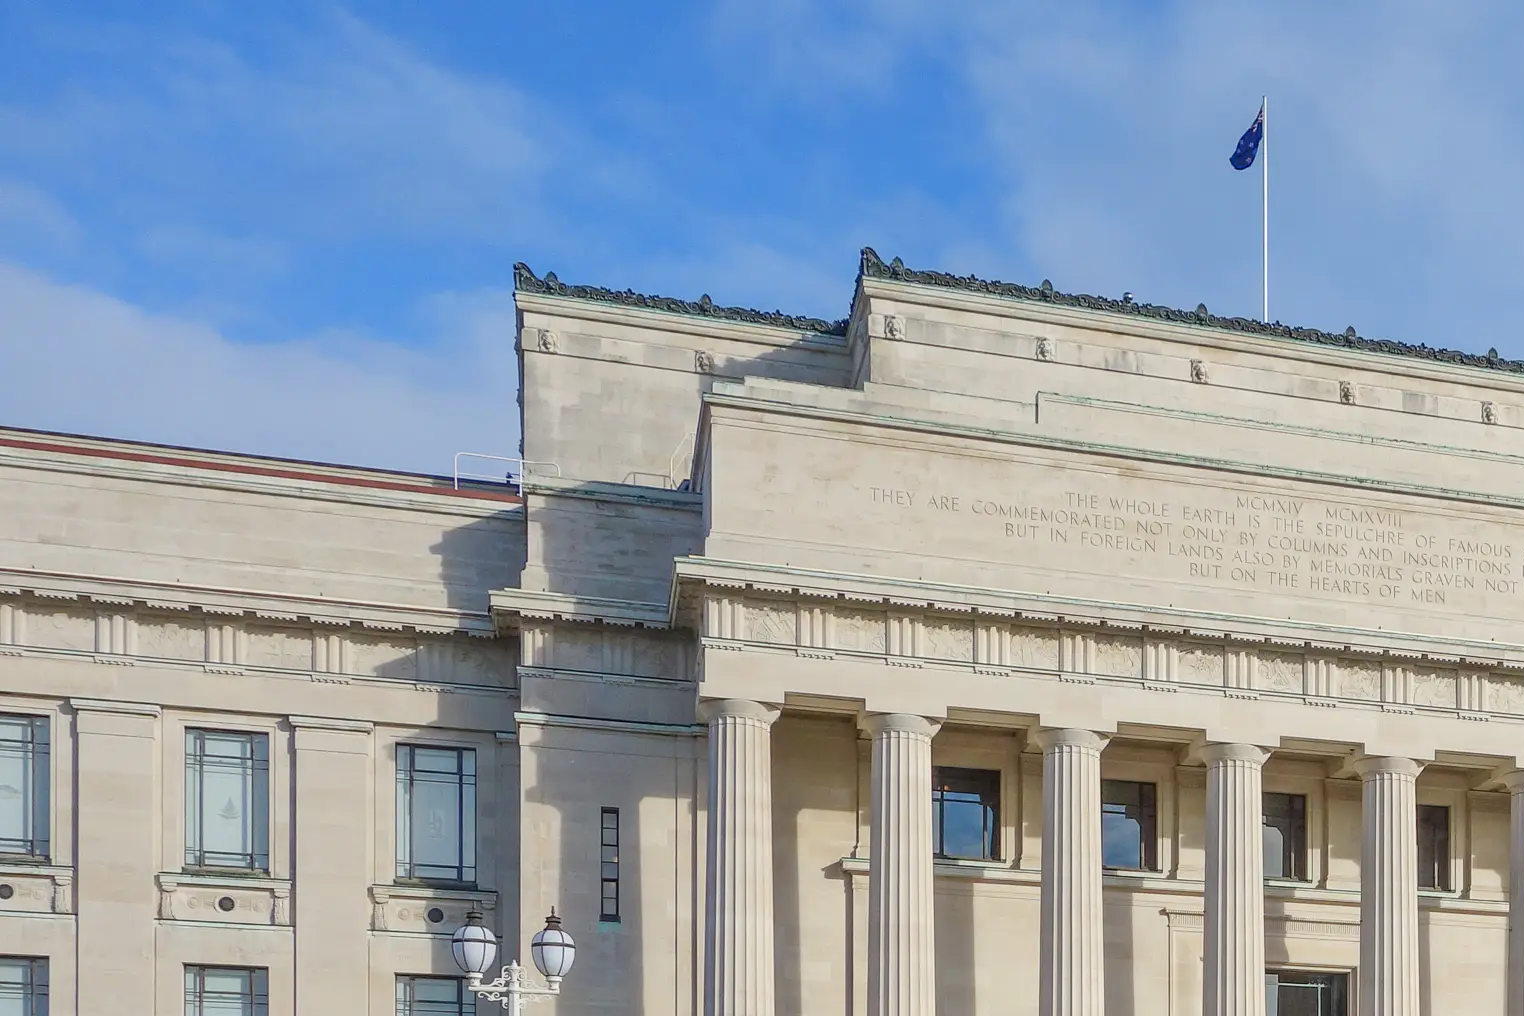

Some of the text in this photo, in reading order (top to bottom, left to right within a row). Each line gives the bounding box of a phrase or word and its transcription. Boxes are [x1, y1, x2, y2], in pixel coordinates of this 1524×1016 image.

[869, 487, 916, 506] THEY
[928, 495, 960, 511] ARE
[971, 500, 1125, 531] COMMEMORATED
[1136, 520, 1172, 537] NOT
[1182, 525, 1227, 543] ONLY
[1239, 531, 1258, 546] BY
[1267, 535, 1348, 557] COLUMNS
[1357, 546, 1393, 562] AND
[1403, 551, 1511, 576] INSCRIPTIONS
[1066, 492, 1099, 509] THE
[1109, 497, 1170, 518] WHOLE
[1183, 506, 1236, 526] EARTH
[1248, 514, 1261, 529] IS
[1271, 516, 1304, 533] THE
[1316, 522, 1404, 546] SEPULCHRE
[1415, 534, 1436, 549] OF
[1448, 538, 1512, 558] FAMOUS
[1236, 496, 1402, 528] MCMXIV MCMXVIII
[1005, 523, 1040, 540] BUT
[1050, 528, 1067, 543] IN
[1080, 531, 1157, 553] FOREIGN
[1168, 541, 1223, 561] LANDS
[1232, 551, 1274, 567] ALSO
[1283, 554, 1301, 569] BY
[1310, 559, 1403, 582] MEMORIALS
[1412, 570, 1475, 589] GRAVEN
[1485, 578, 1519, 595] NOT
[1189, 562, 1446, 604] BUT ON THE HEARTS OF MEN
